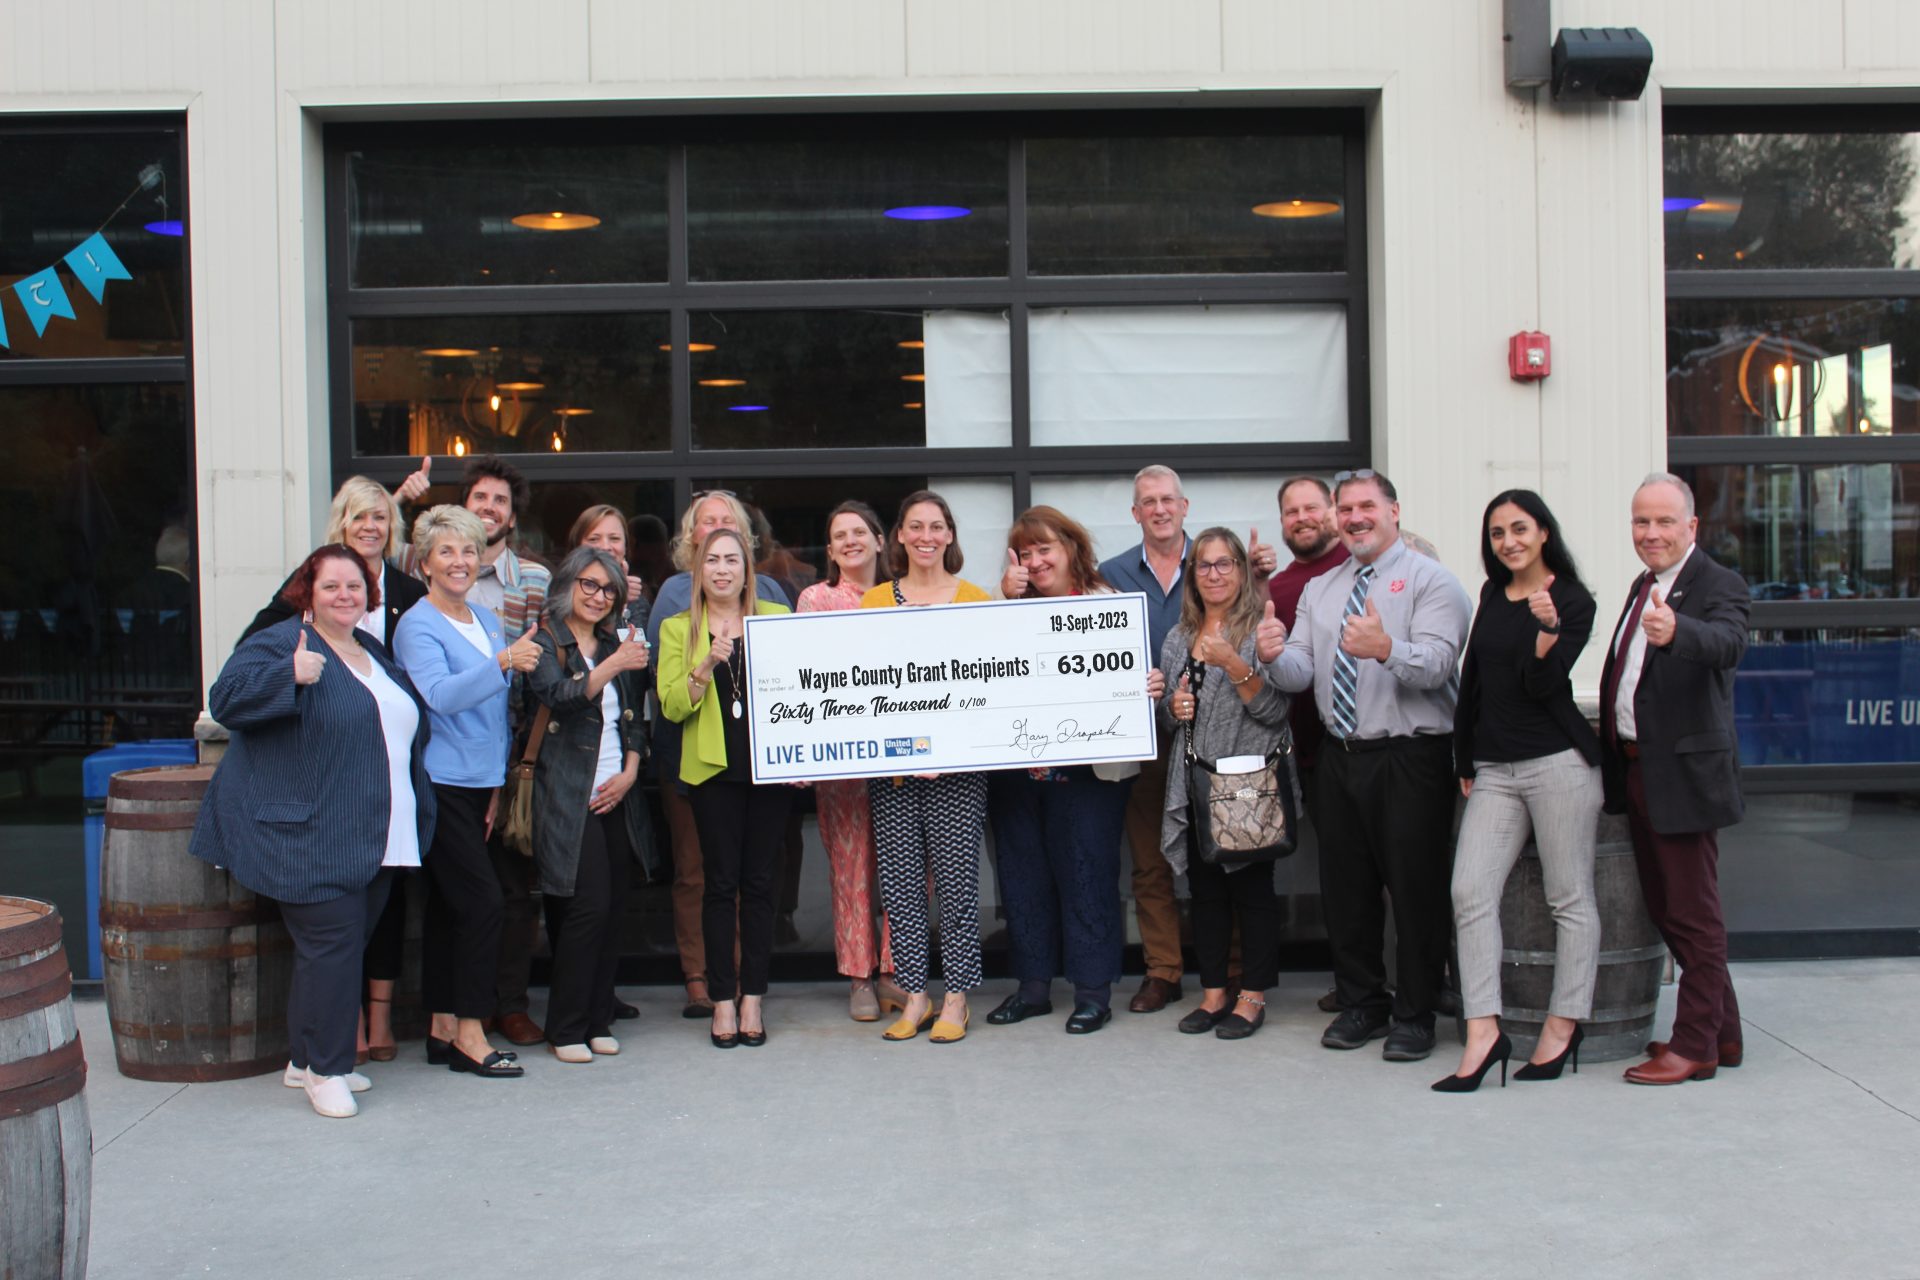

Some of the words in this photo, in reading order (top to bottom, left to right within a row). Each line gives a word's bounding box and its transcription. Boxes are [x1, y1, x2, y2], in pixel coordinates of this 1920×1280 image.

[1050, 610, 1129, 634] 19-Sept-2023
[798, 667, 848, 693] Wayne
[851, 664, 903, 689] County
[907, 661, 948, 683] Grant
[950, 656, 1030, 683] Recipients
[1057, 650, 1134, 677] 63,000
[1112, 690, 1141, 698] DOLLARS
[769, 702, 815, 724] Sixty
[819, 698, 867, 720] Three
[870, 692, 951, 717] Thousand
[959, 696, 987, 710] 0/100
[1846, 699, 1894, 726] LIVE
[1901, 699, 1920, 726] U
[766, 744, 805, 765] LIVE
[812, 740, 879, 762] UNITED
[885, 738, 912, 748] United
[895, 747, 912, 756] Way
